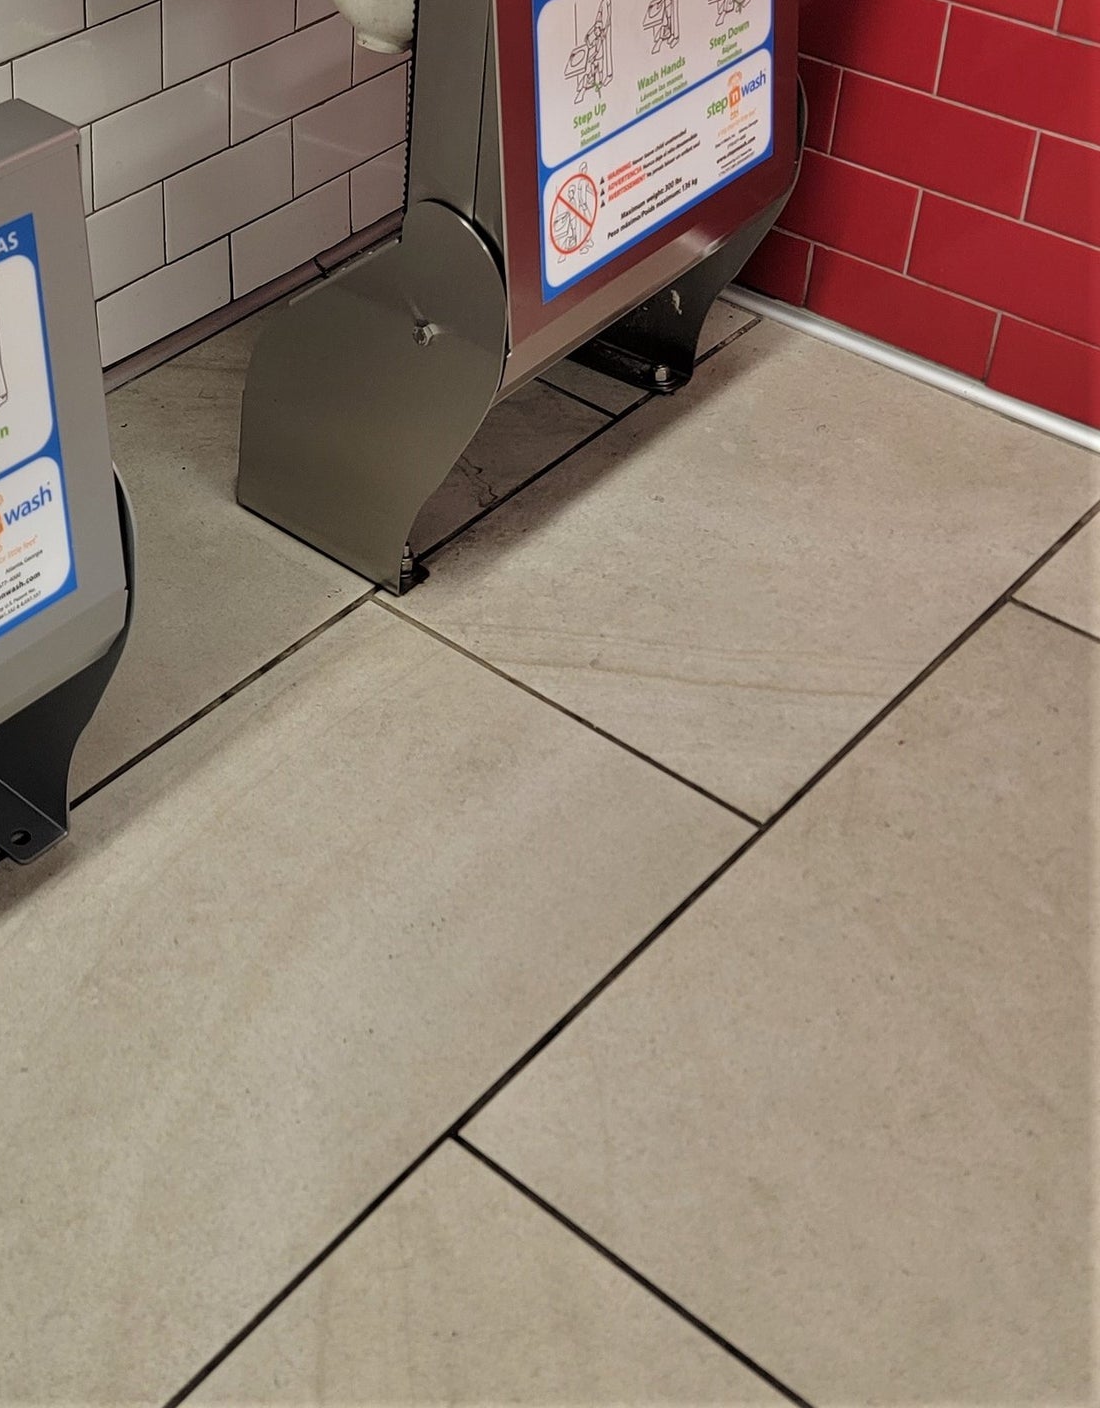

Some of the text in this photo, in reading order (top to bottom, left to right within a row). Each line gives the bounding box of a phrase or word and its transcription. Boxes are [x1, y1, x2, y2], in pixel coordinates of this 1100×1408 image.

[709, 20, 750, 50] Step Down
[637, 56, 686, 91] Wash Hands
[706, 96, 728, 119] step
[741, 69, 766, 97] wash
[573, 103, 607, 129] Step Up
[621, 200, 646, 220] Maximum
[665, 179, 675, 192] 300
[675, 176, 683, 185] lbs
[4, 485, 53, 526] wash
